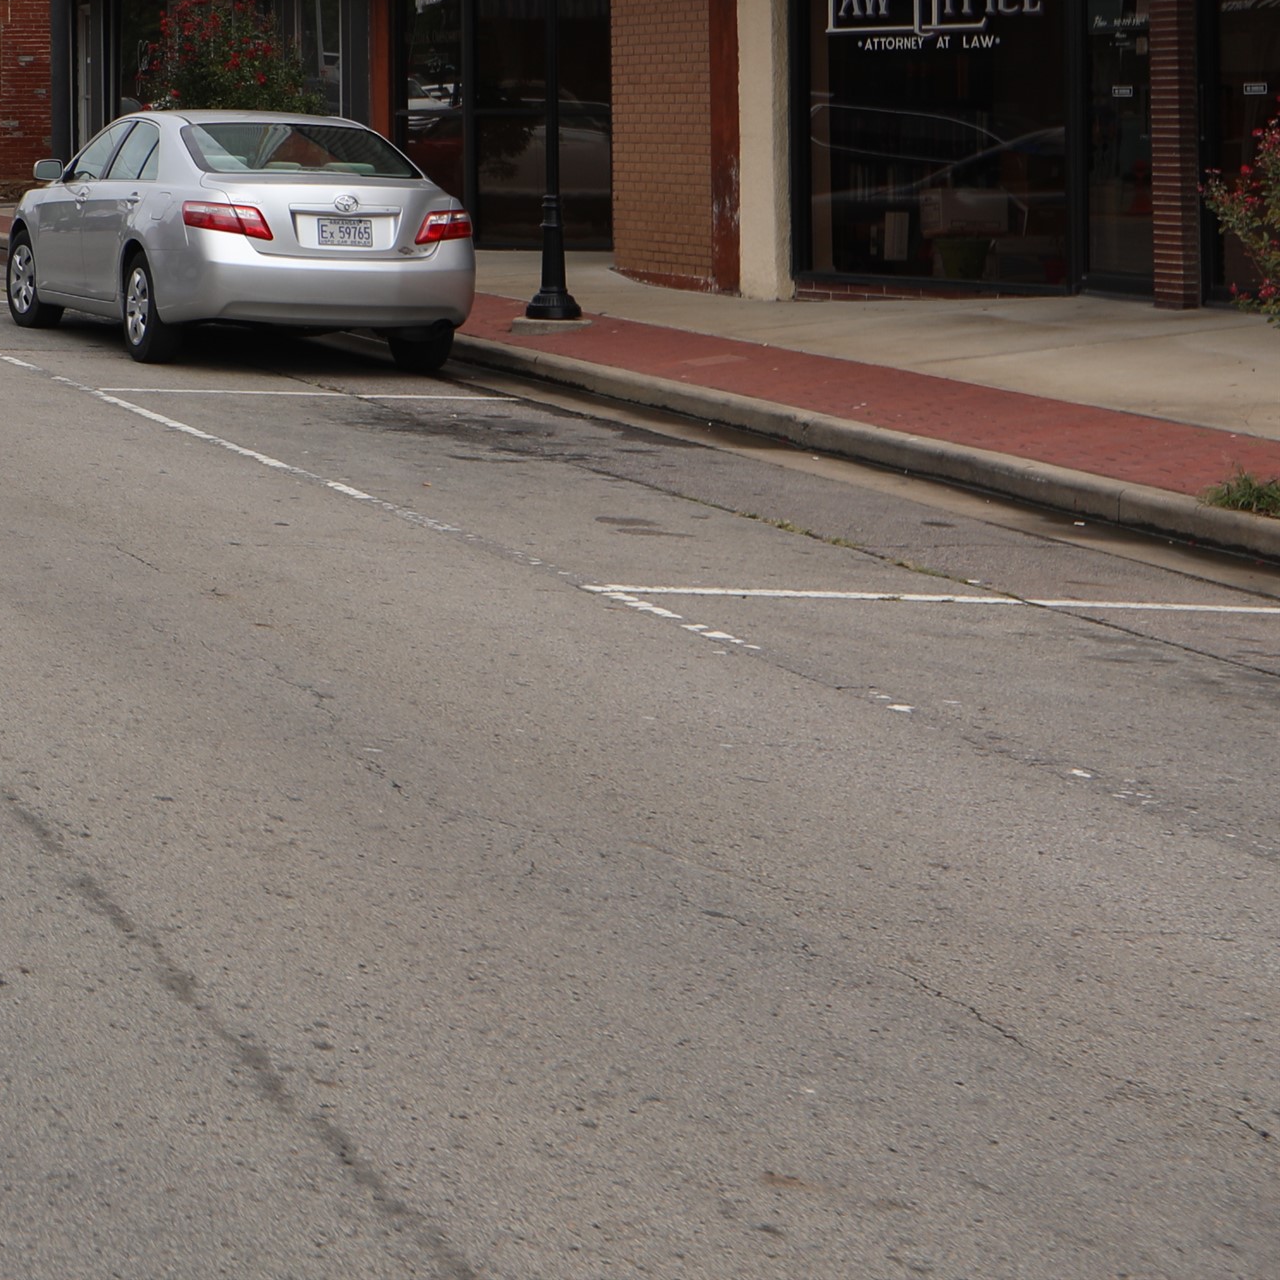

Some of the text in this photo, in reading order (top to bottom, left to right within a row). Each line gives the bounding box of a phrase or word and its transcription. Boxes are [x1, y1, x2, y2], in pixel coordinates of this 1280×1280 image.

[864, 34, 995, 51] ATTORNEY AT LAW
[338, 226, 371, 240] 59765
